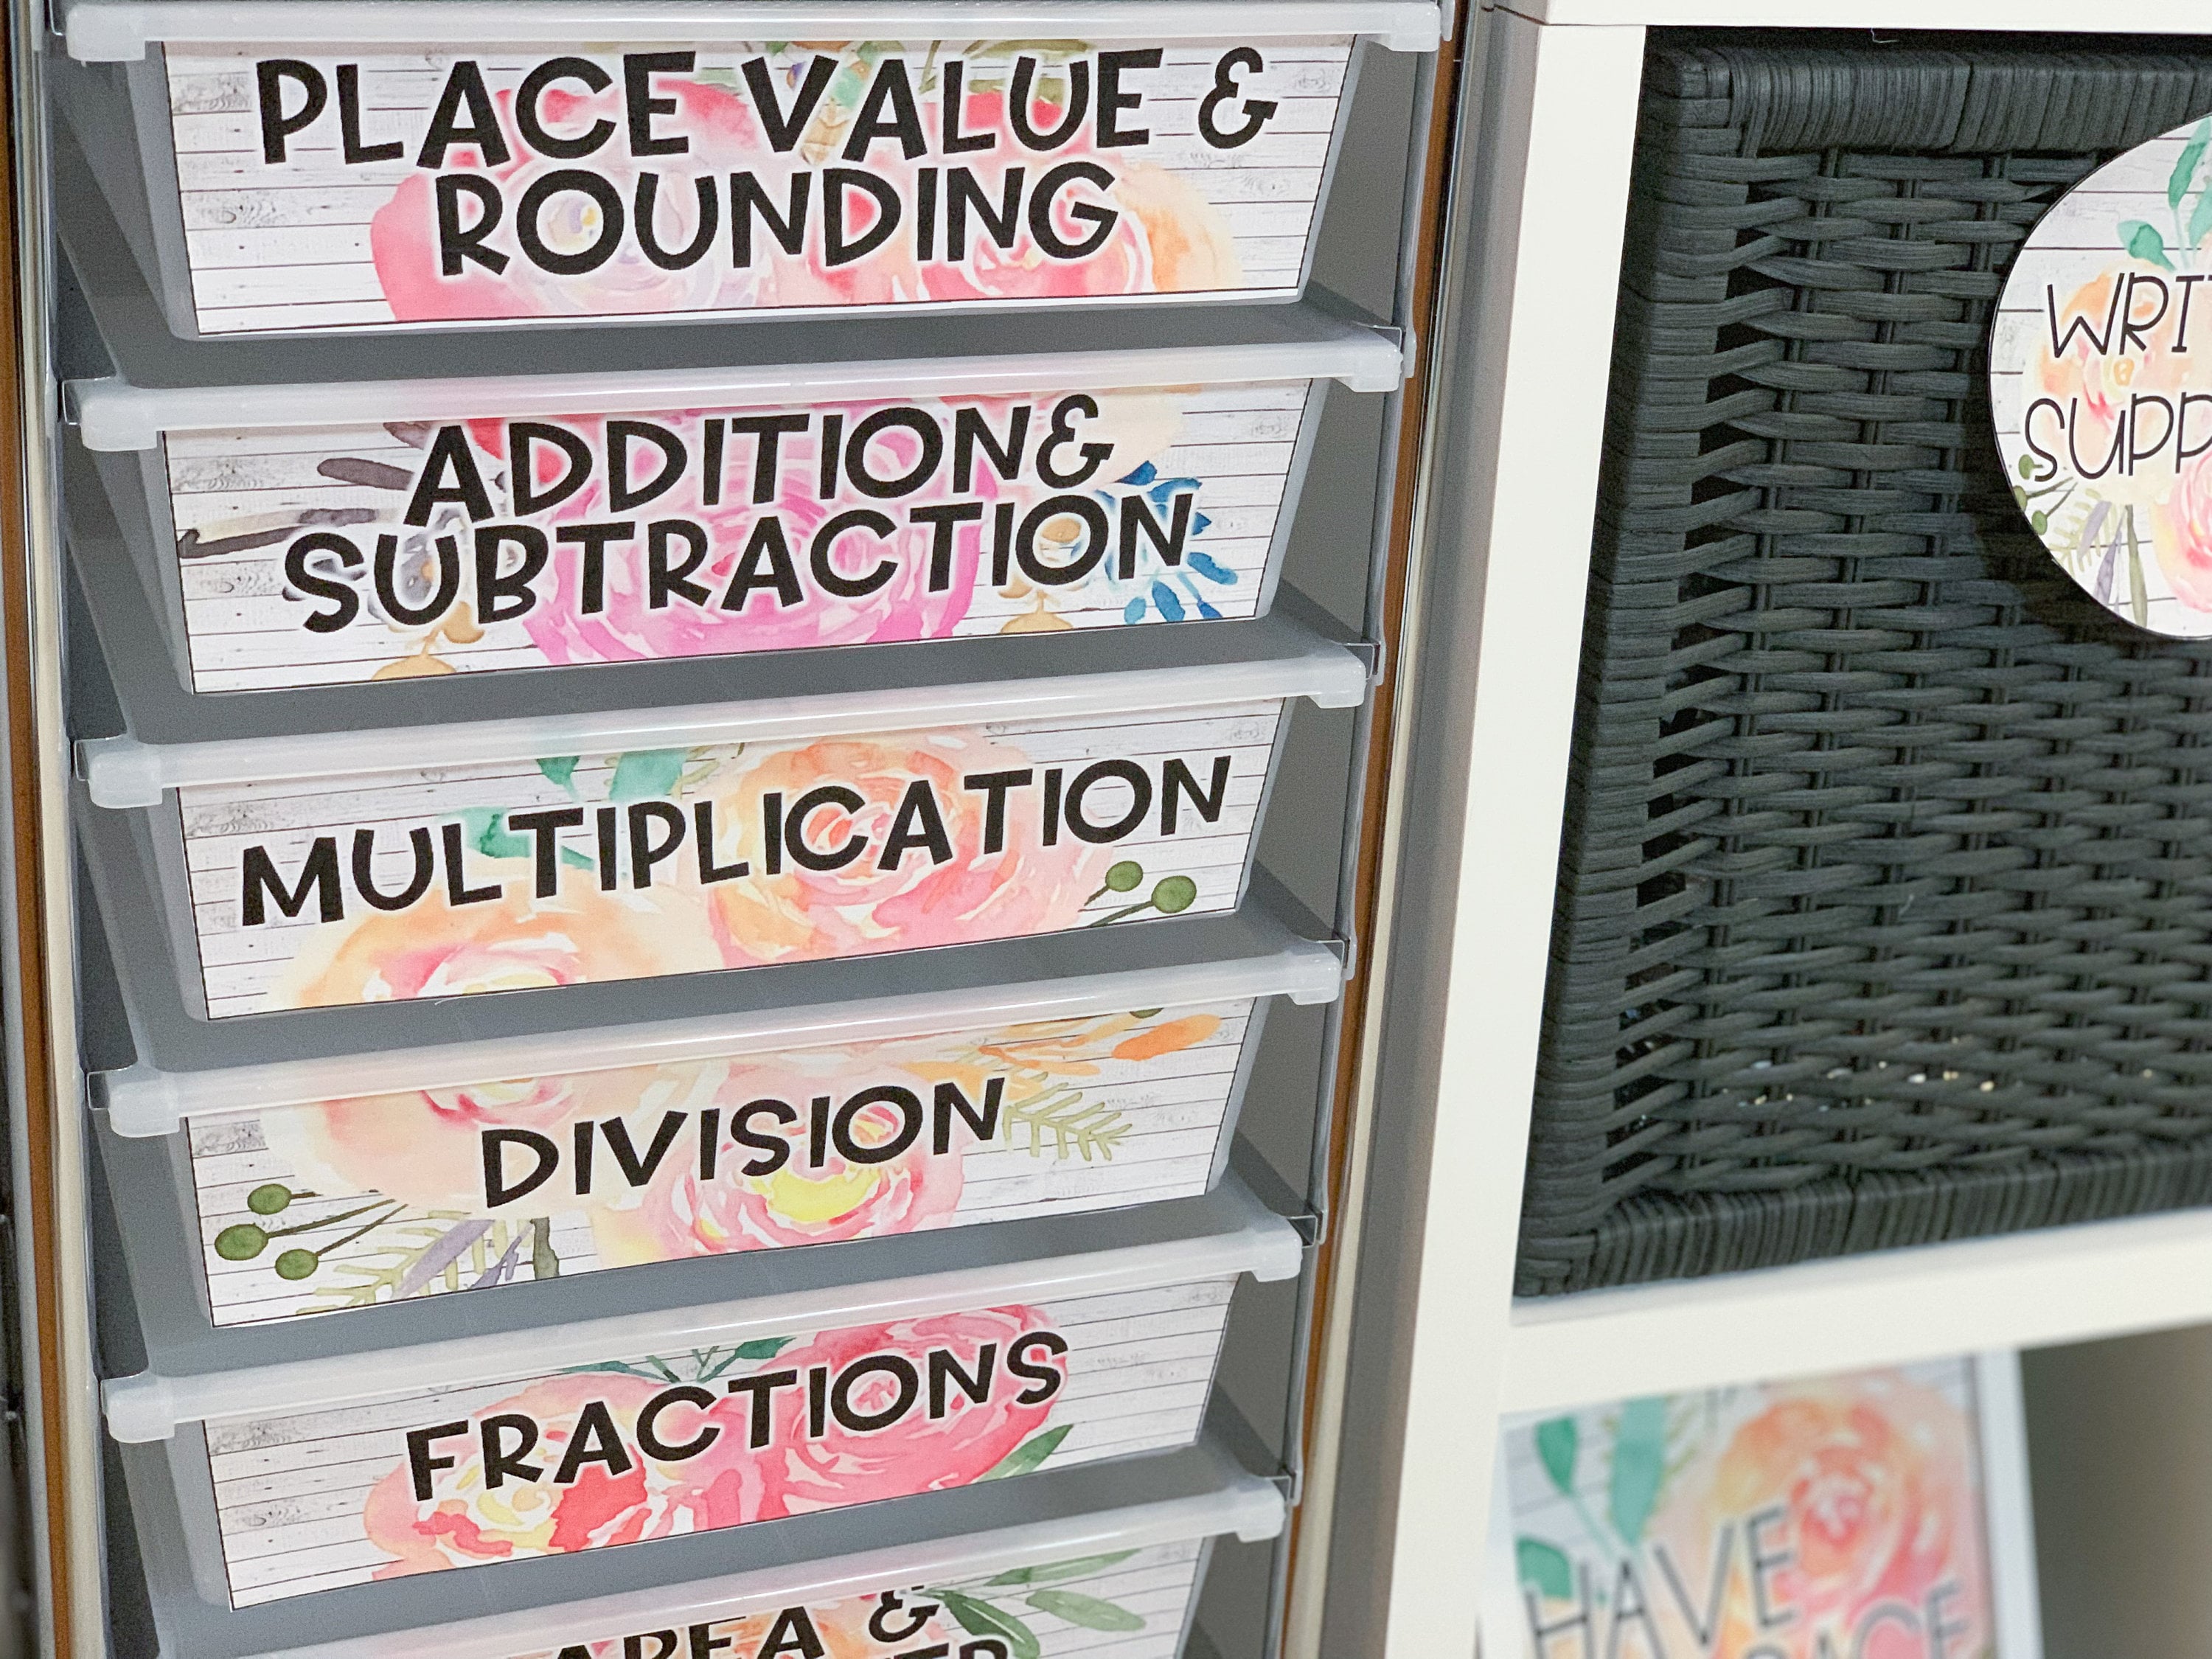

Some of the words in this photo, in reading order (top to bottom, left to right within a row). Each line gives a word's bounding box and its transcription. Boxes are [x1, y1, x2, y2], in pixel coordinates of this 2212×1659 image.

[257, 51, 696, 169] PLACE
[741, 48, 1164, 162] VALUE
[1198, 46, 1279, 149] &
[435, 161, 1119, 276] ROUNDING
[2047, 272, 2212, 358] WRI
[285, 493, 1194, 633] SUBTRACTION
[242, 755, 1231, 926] MULTIPLICATION
[481, 1077, 1005, 1208] DIVISION
[406, 1332, 1068, 1502] FRACTIONS
[557, 1606, 826, 1659] EA
[1524, 1504, 1798, 1659] HAVE
